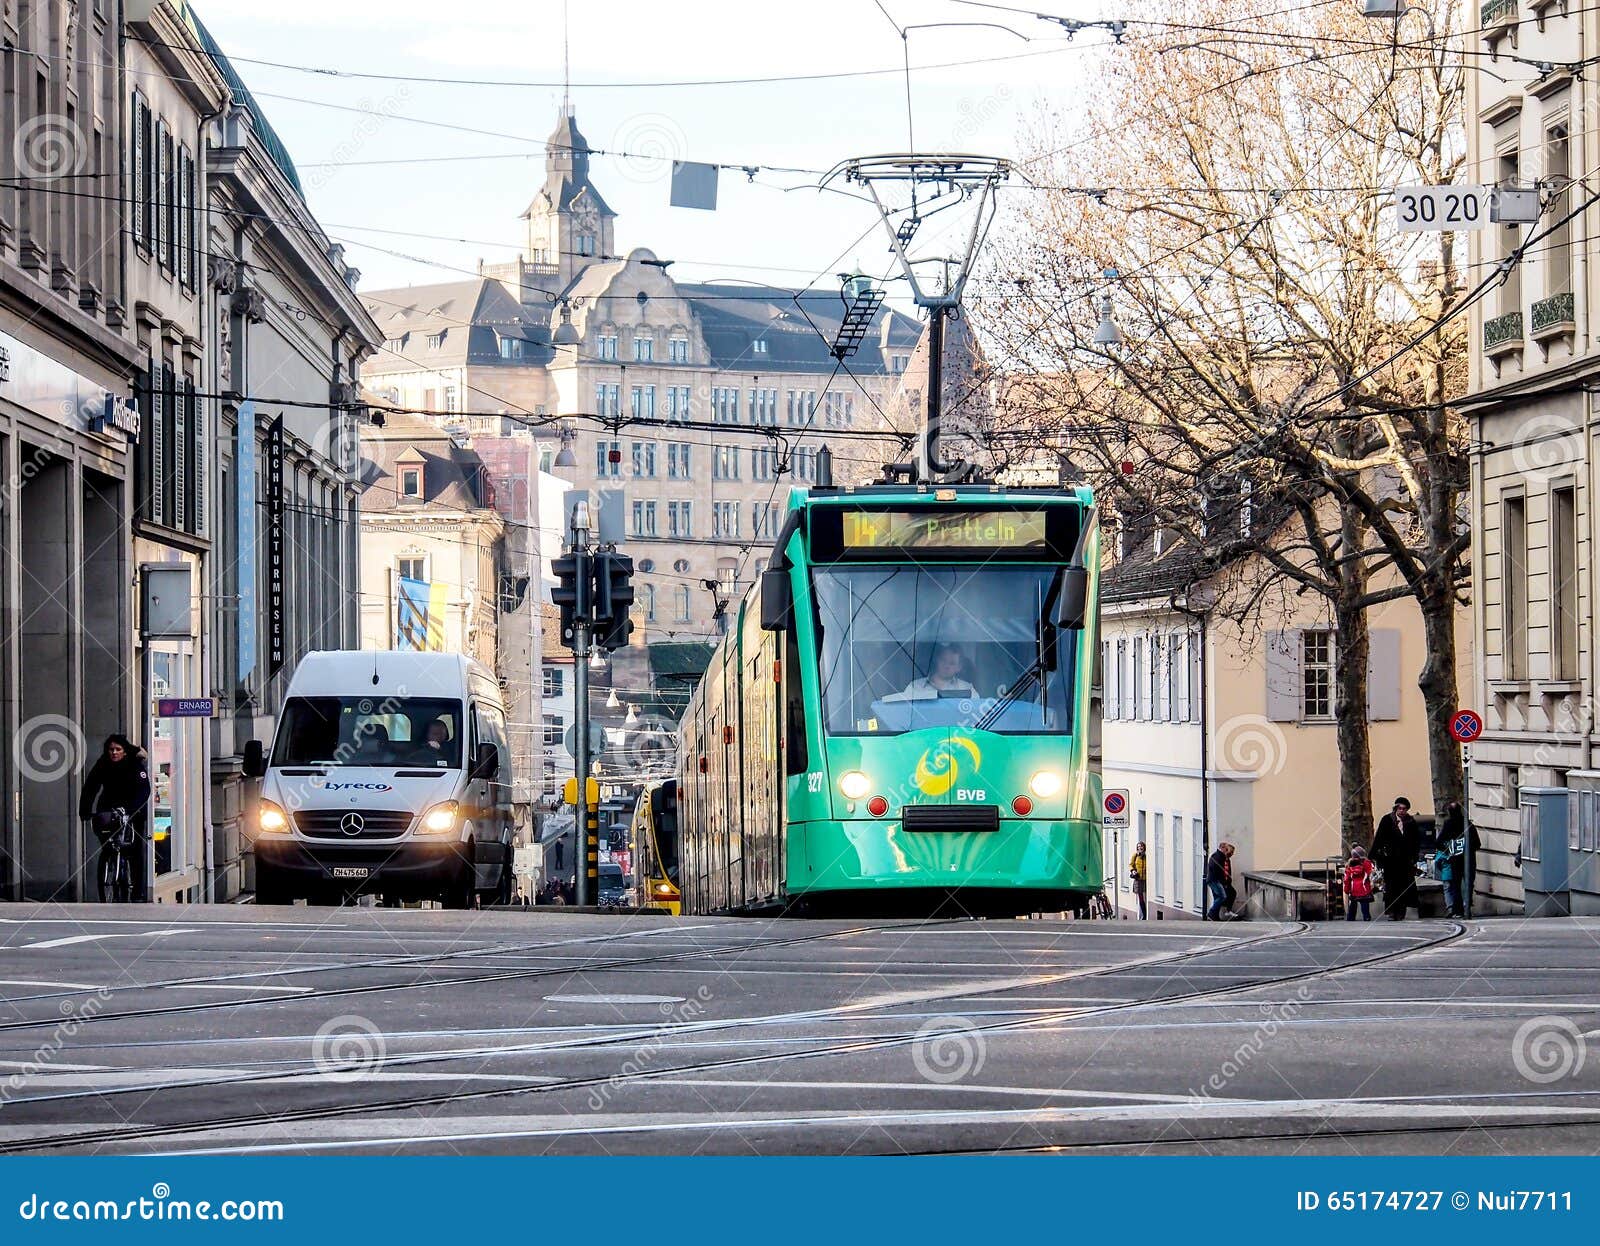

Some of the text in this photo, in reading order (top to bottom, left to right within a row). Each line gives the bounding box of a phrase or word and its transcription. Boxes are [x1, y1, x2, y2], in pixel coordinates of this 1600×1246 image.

[1402, 193, 1478, 222] 30 20
[927, 517, 1016, 542] Pratteln
[272, 430, 281, 661] ARCHITEKTURMUSEUM
[325, 782, 387, 791] Lyreco
[807, 772, 823, 793] 327
[957, 789, 986, 801] BVB
